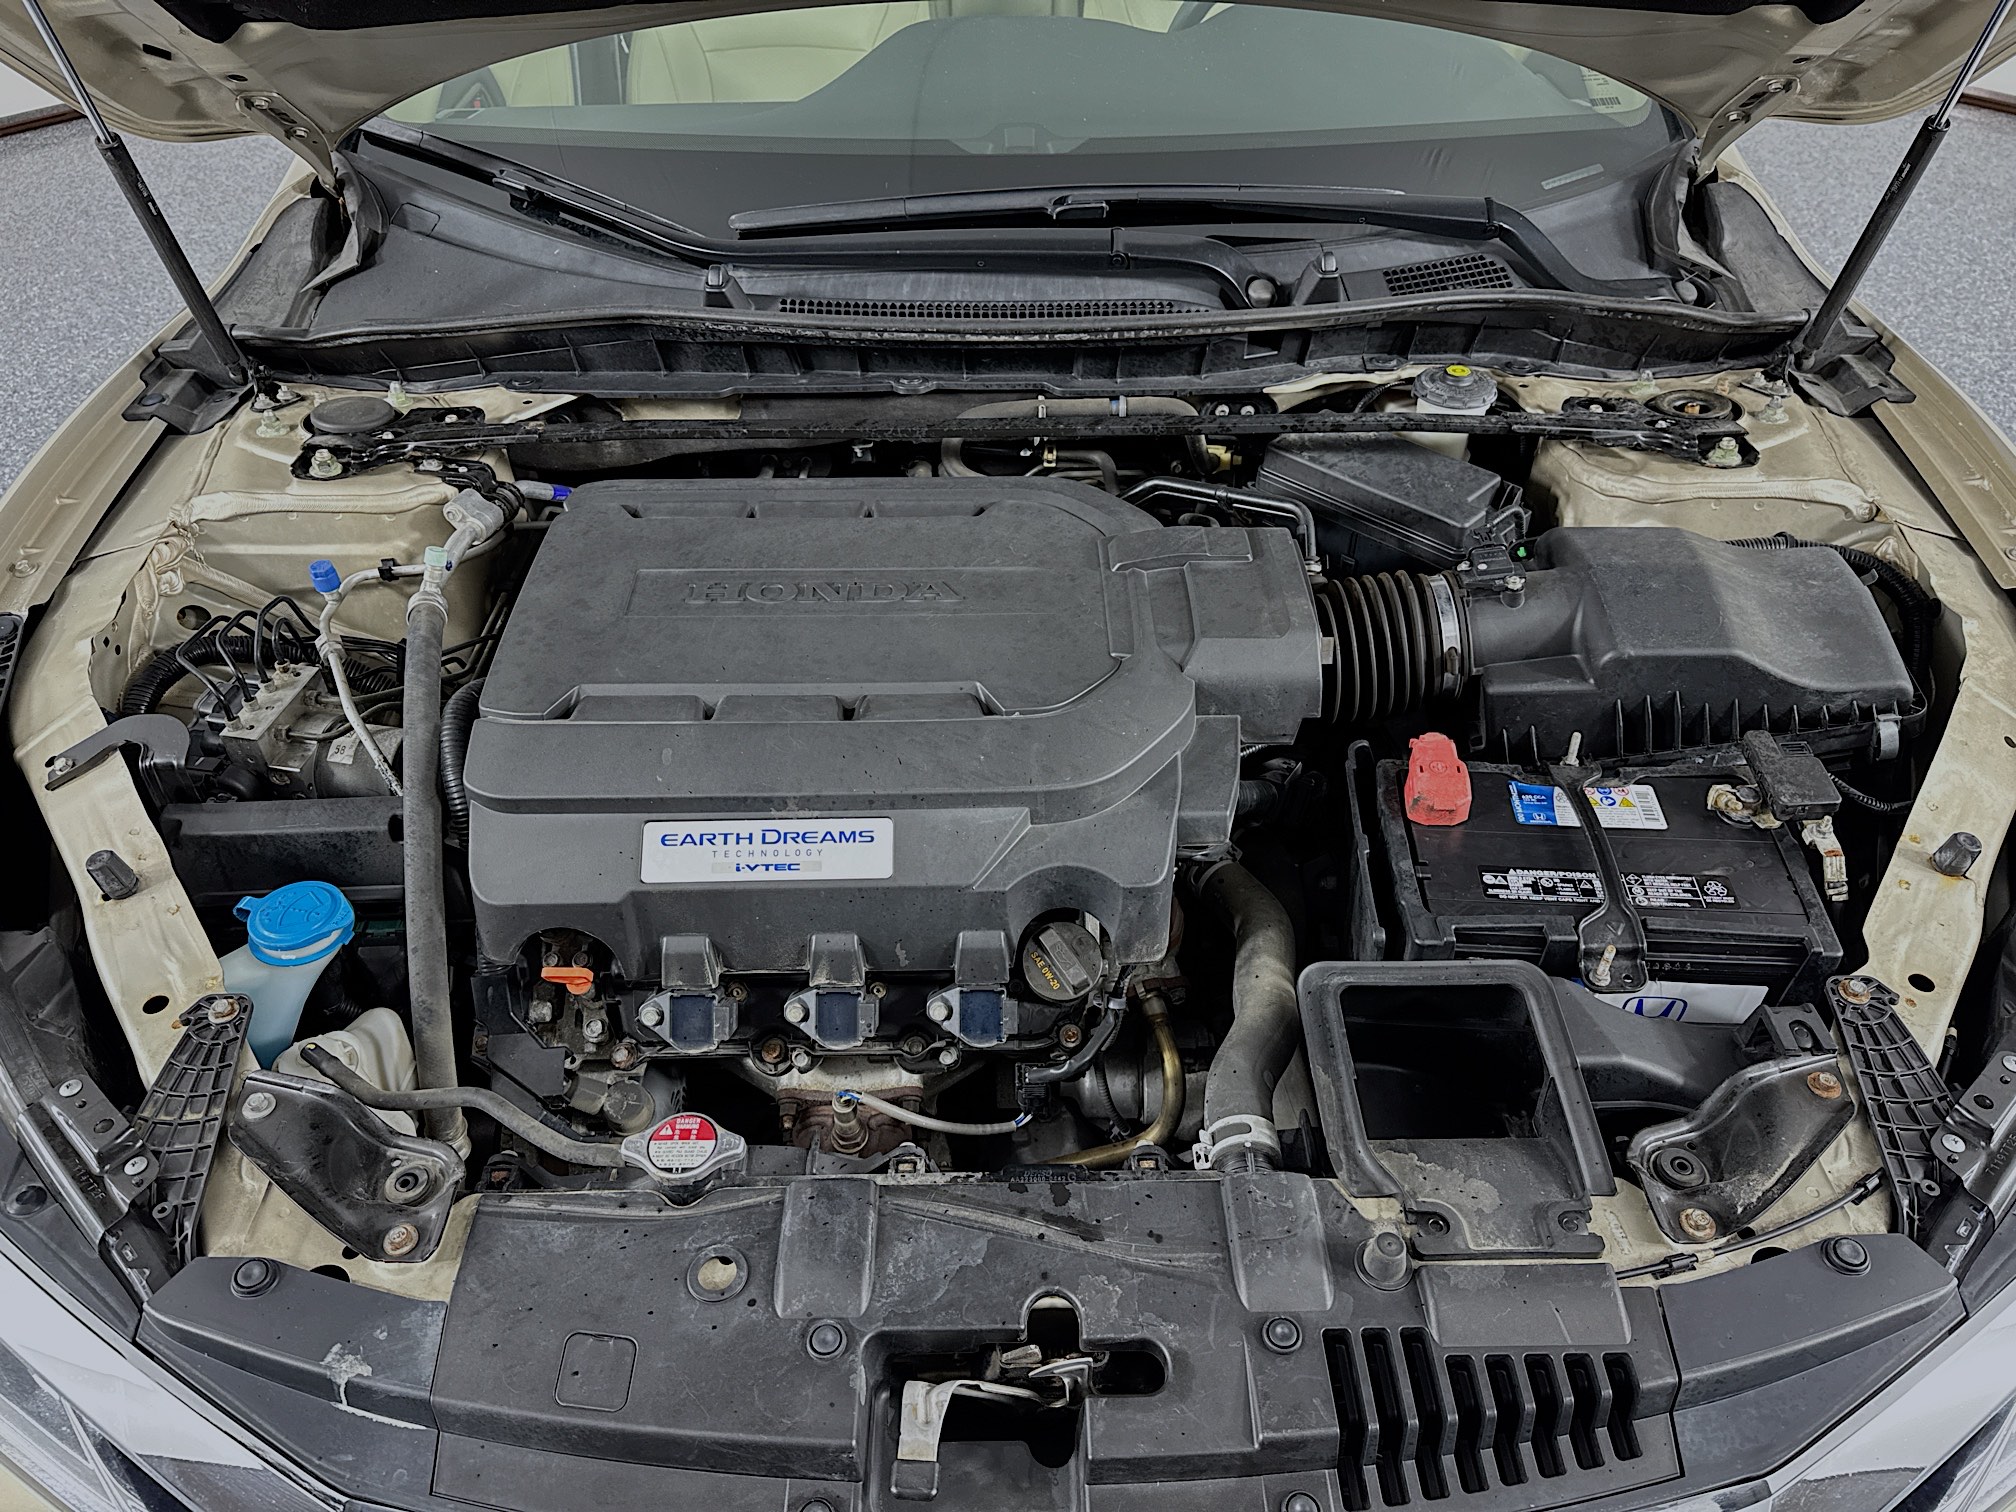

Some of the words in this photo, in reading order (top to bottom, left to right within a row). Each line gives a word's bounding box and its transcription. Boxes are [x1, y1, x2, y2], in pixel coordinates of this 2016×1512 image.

[682, 581, 966, 604] HONDA
[334, 744, 347, 755] 58
[660, 832, 753, 847] EARTH
[761, 829, 875, 846] DREAMS
[711, 848, 823, 859] TECHNOLOGY
[735, 863, 801, 873] i-VTEC
[1031, 951, 1046, 969] SAE
[1041, 965, 1060, 990] 0W-20
